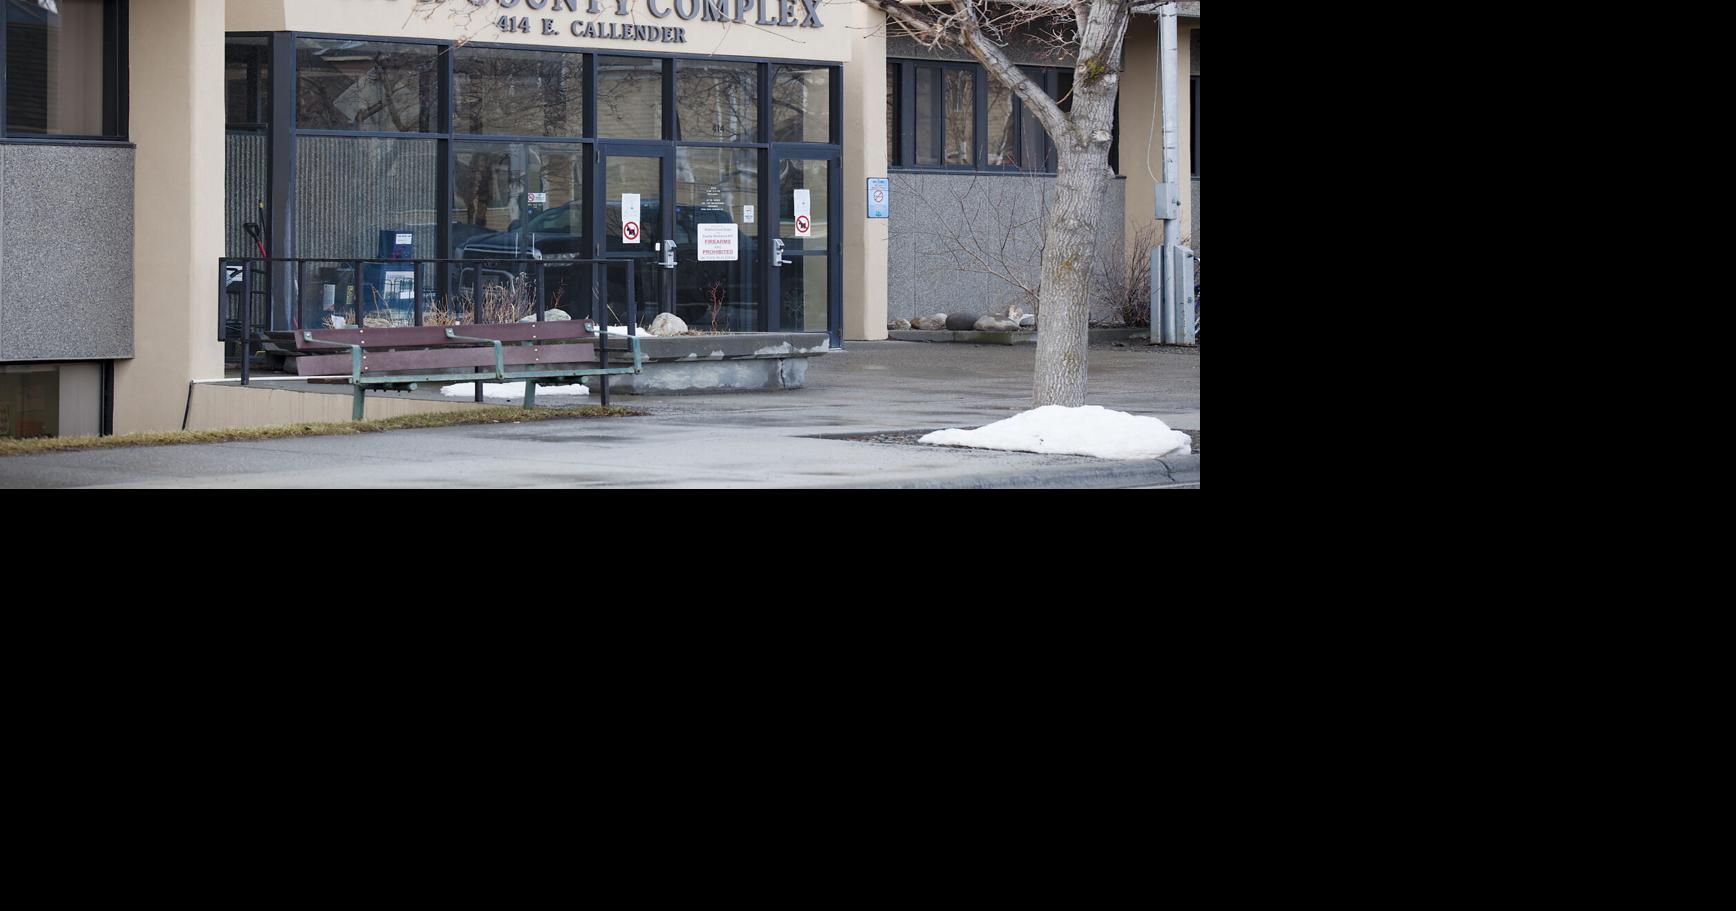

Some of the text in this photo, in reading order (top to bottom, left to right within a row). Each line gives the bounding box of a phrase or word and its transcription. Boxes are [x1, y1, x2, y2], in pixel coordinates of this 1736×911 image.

[647, 0, 824, 28] COMPLEX
[496, 15, 687, 43] 414 E. CALLENDER
